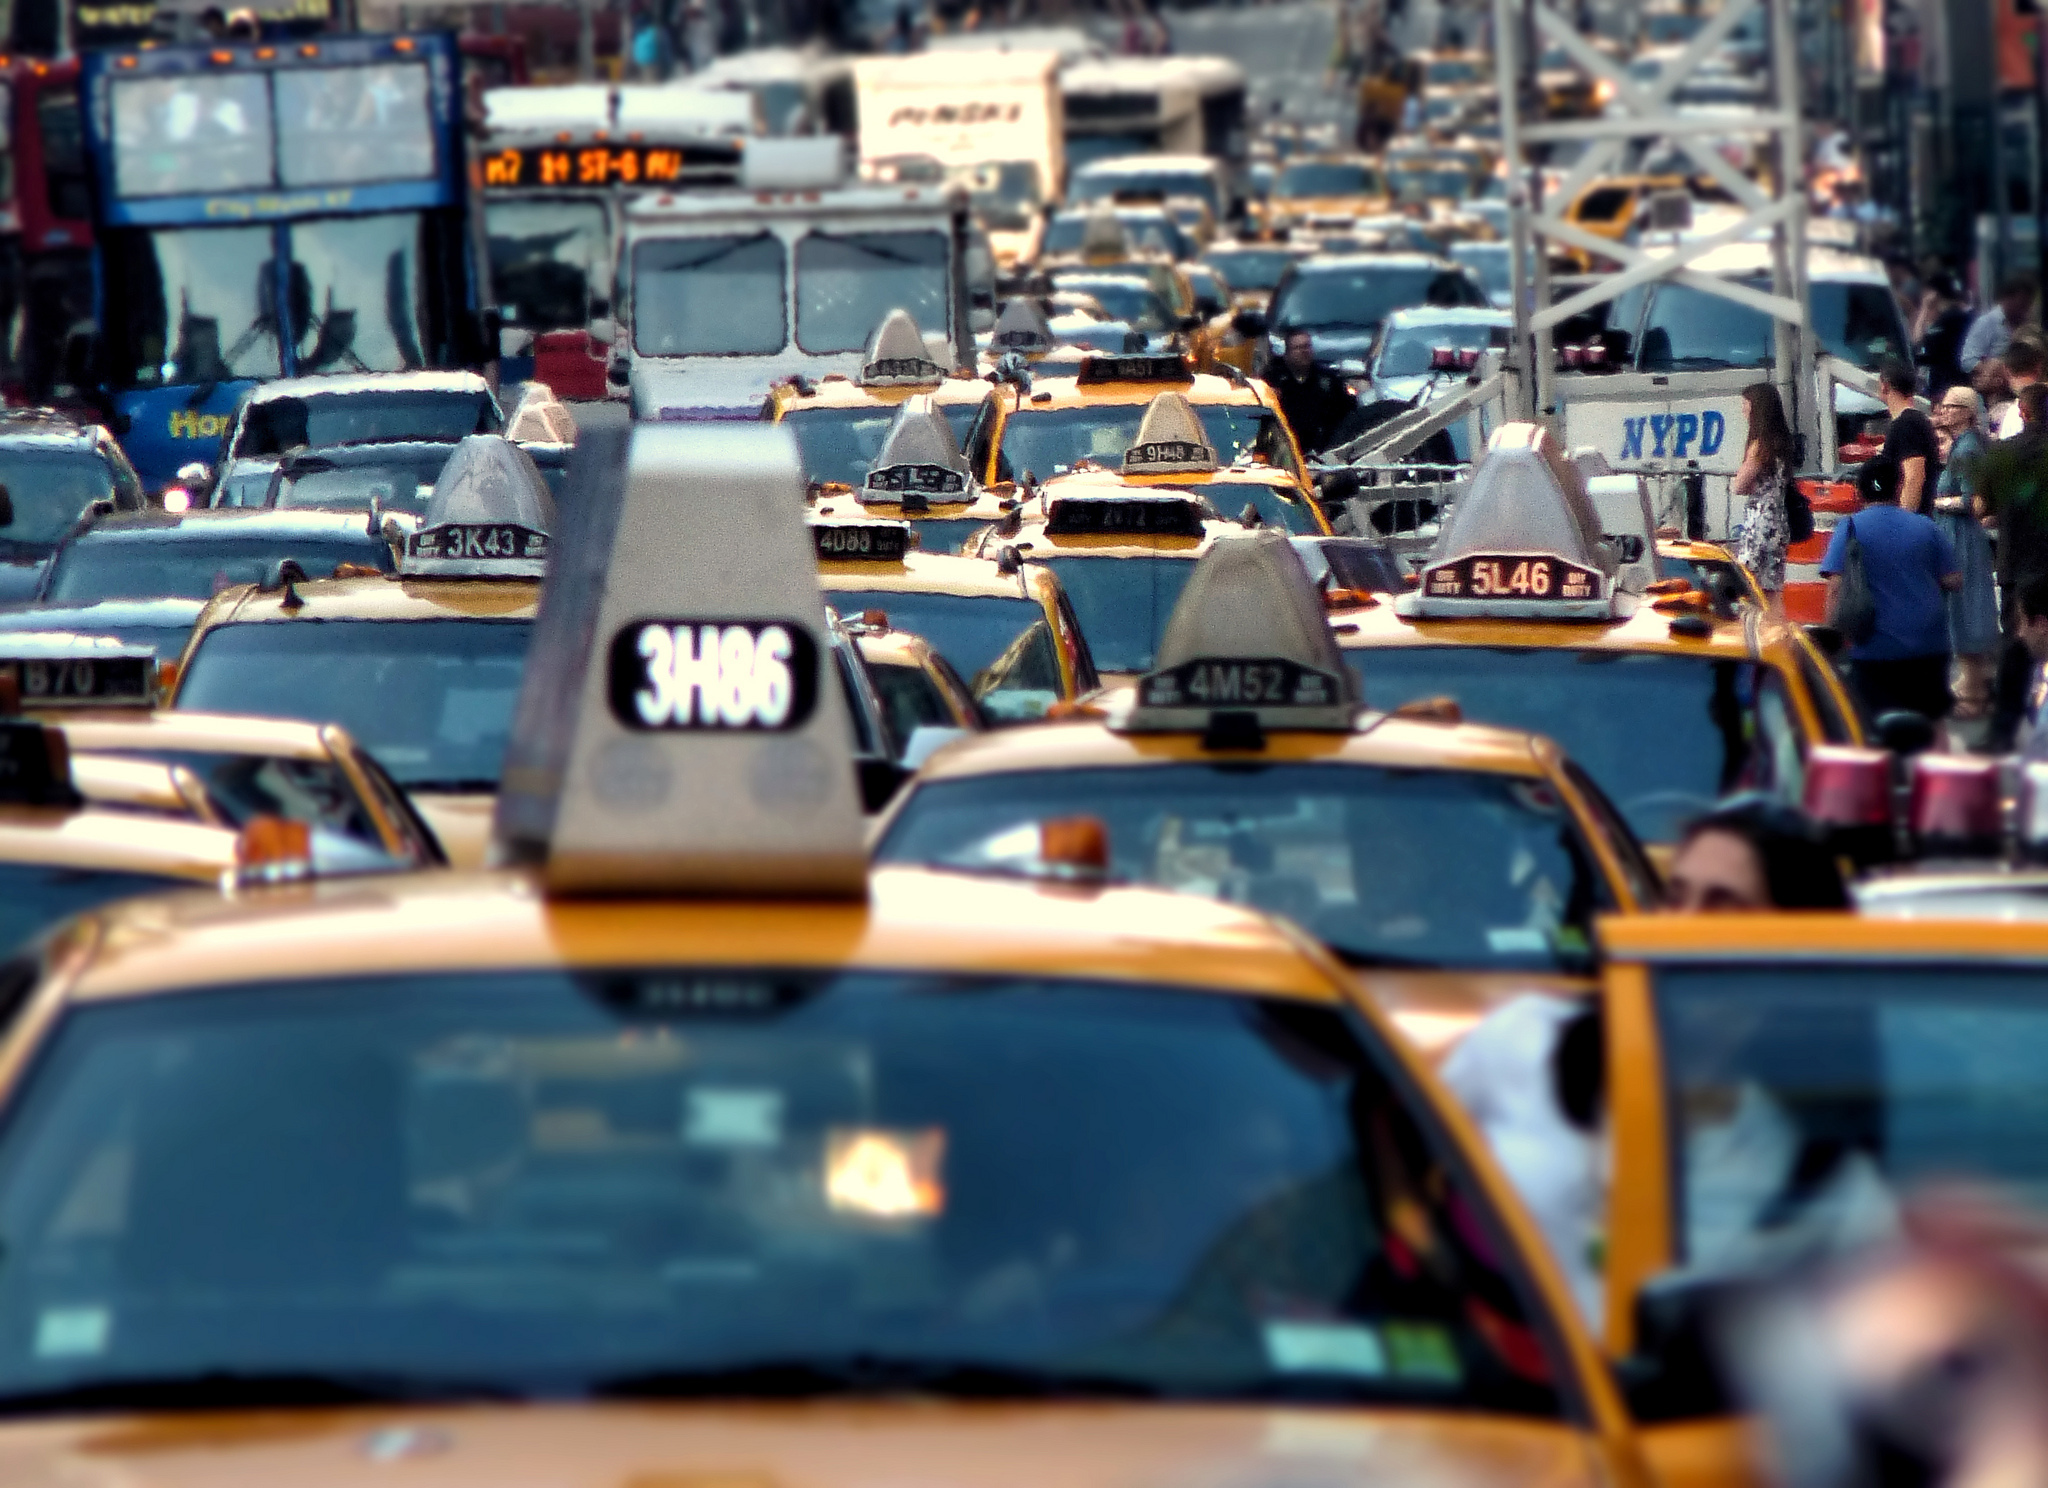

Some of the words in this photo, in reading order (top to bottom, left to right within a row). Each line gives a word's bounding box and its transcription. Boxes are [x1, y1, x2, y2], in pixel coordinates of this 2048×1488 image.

[1620, 410, 1725, 460] NYPD
[447, 527, 516, 556] 3K43
[1472, 561, 1551, 595] 5L46
[634, 623, 792, 726] 3H86
[1188, 664, 1284, 701] 4M52
